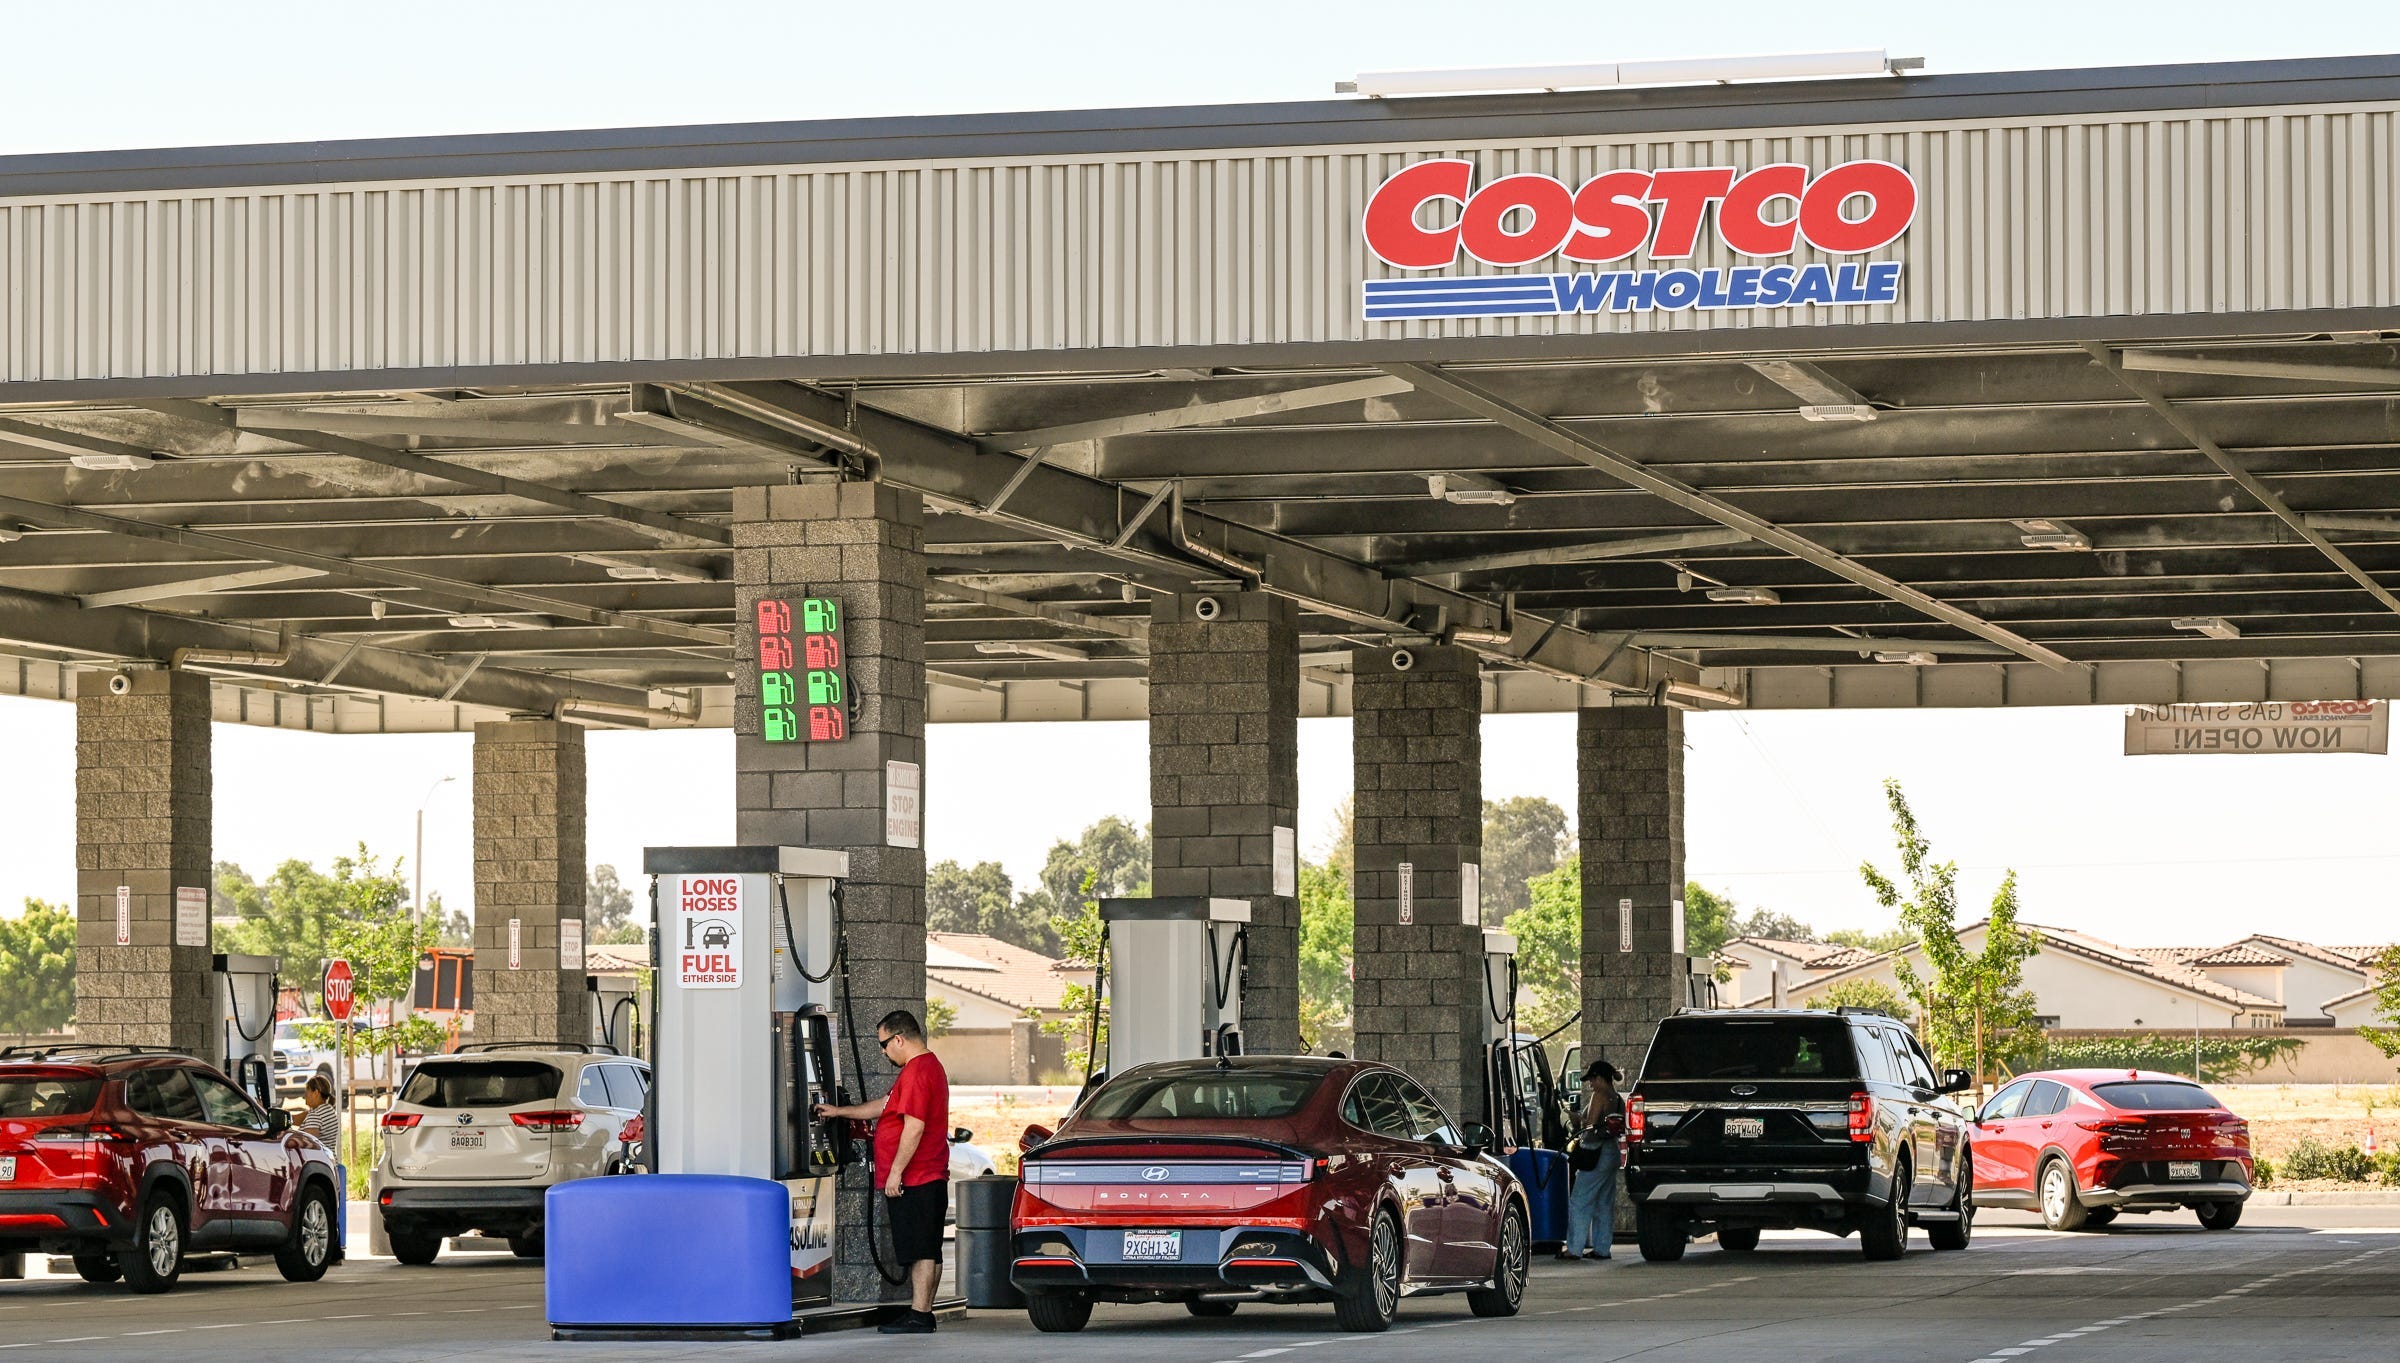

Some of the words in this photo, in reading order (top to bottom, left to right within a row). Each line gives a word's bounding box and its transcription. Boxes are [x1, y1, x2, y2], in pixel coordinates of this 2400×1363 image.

[1364, 160, 1917, 268] COSTCO
[1553, 263, 1900, 312] WHOLESALE
[891, 794, 914, 815] STOP
[887, 817, 918, 838] ENGINE
[682, 879, 737, 896] LONG
[682, 897, 737, 911] HOSES
[564, 941, 578, 952] STOP
[561, 955, 581, 966] ENGINE
[682, 954, 737, 973] FUEL
[682, 974, 714, 983] EITHER
[716, 974, 737, 983] SIDE
[327, 979, 353, 1002] STOP
[1726, 1124, 1762, 1135] 8RTW406
[451, 1137, 483, 1147] 8AQB301
[790, 1224, 828, 1251] ASOLINE
[1126, 1240, 1177, 1256] 9XGH134
